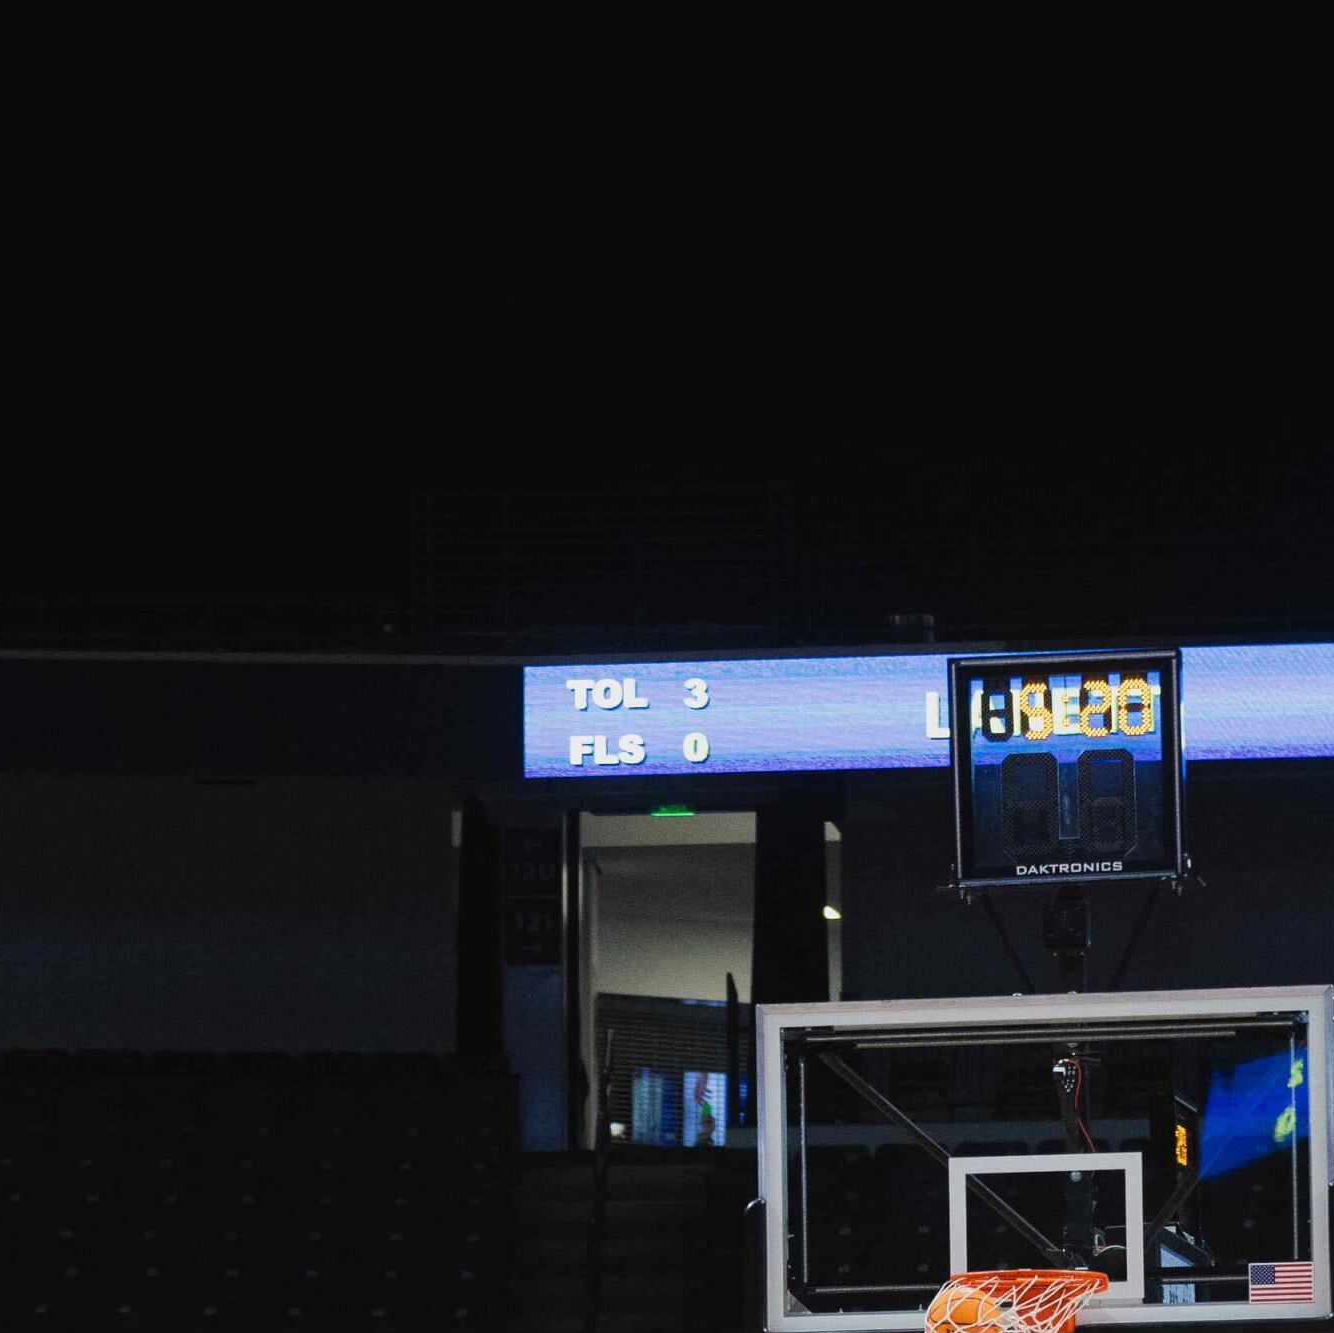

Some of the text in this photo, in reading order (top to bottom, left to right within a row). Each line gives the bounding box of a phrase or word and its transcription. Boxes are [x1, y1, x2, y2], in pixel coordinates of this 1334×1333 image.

[566, 677, 709, 710] TOL 3
[569, 732, 709, 765] FLS 0
[1016, 860, 1124, 876] DAKTRONICS
